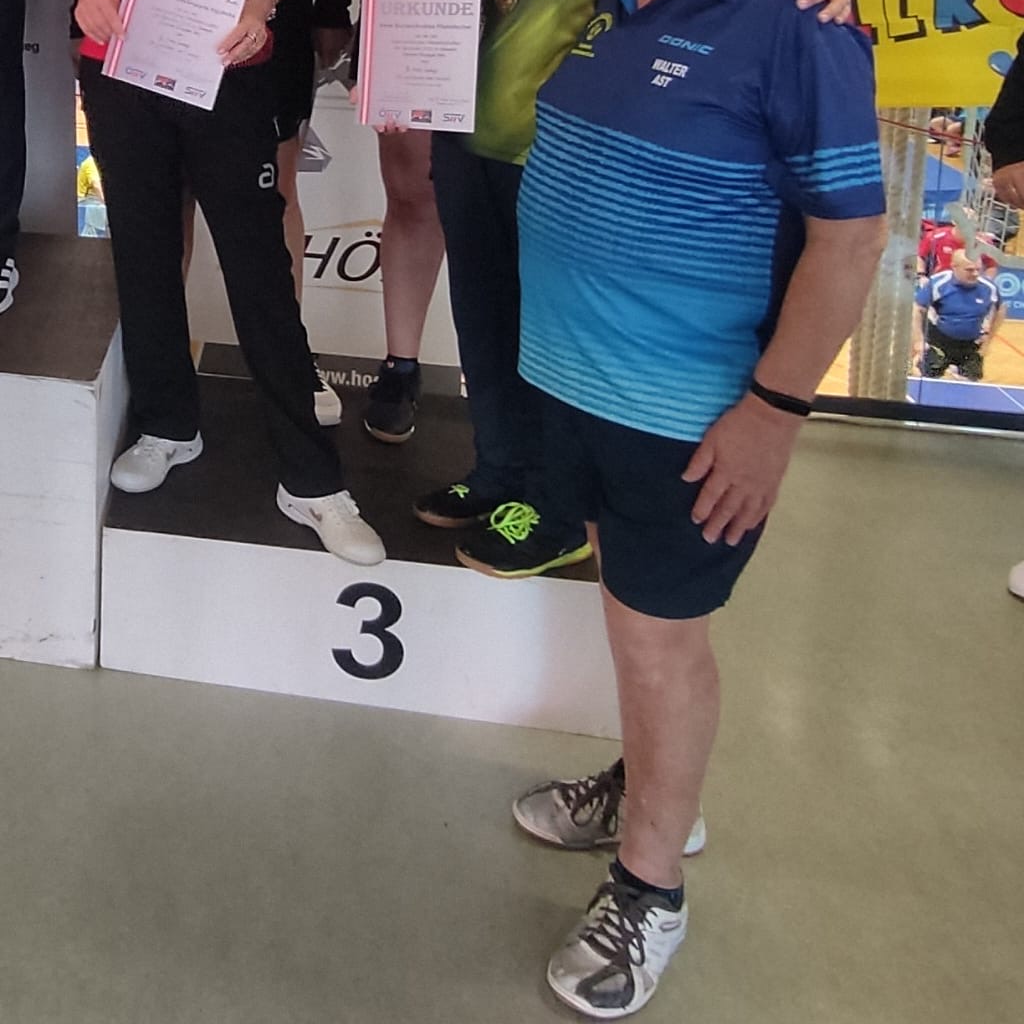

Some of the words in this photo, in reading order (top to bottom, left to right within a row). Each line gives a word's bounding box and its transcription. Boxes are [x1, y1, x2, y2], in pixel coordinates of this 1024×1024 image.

[380, 1, 475, 17] URKUNDE
[657, 34, 716, 56] DONIC
[651, 58, 690, 78] WALTER
[650, 74, 673, 88] AST
[331, 581, 405, 680] 3
